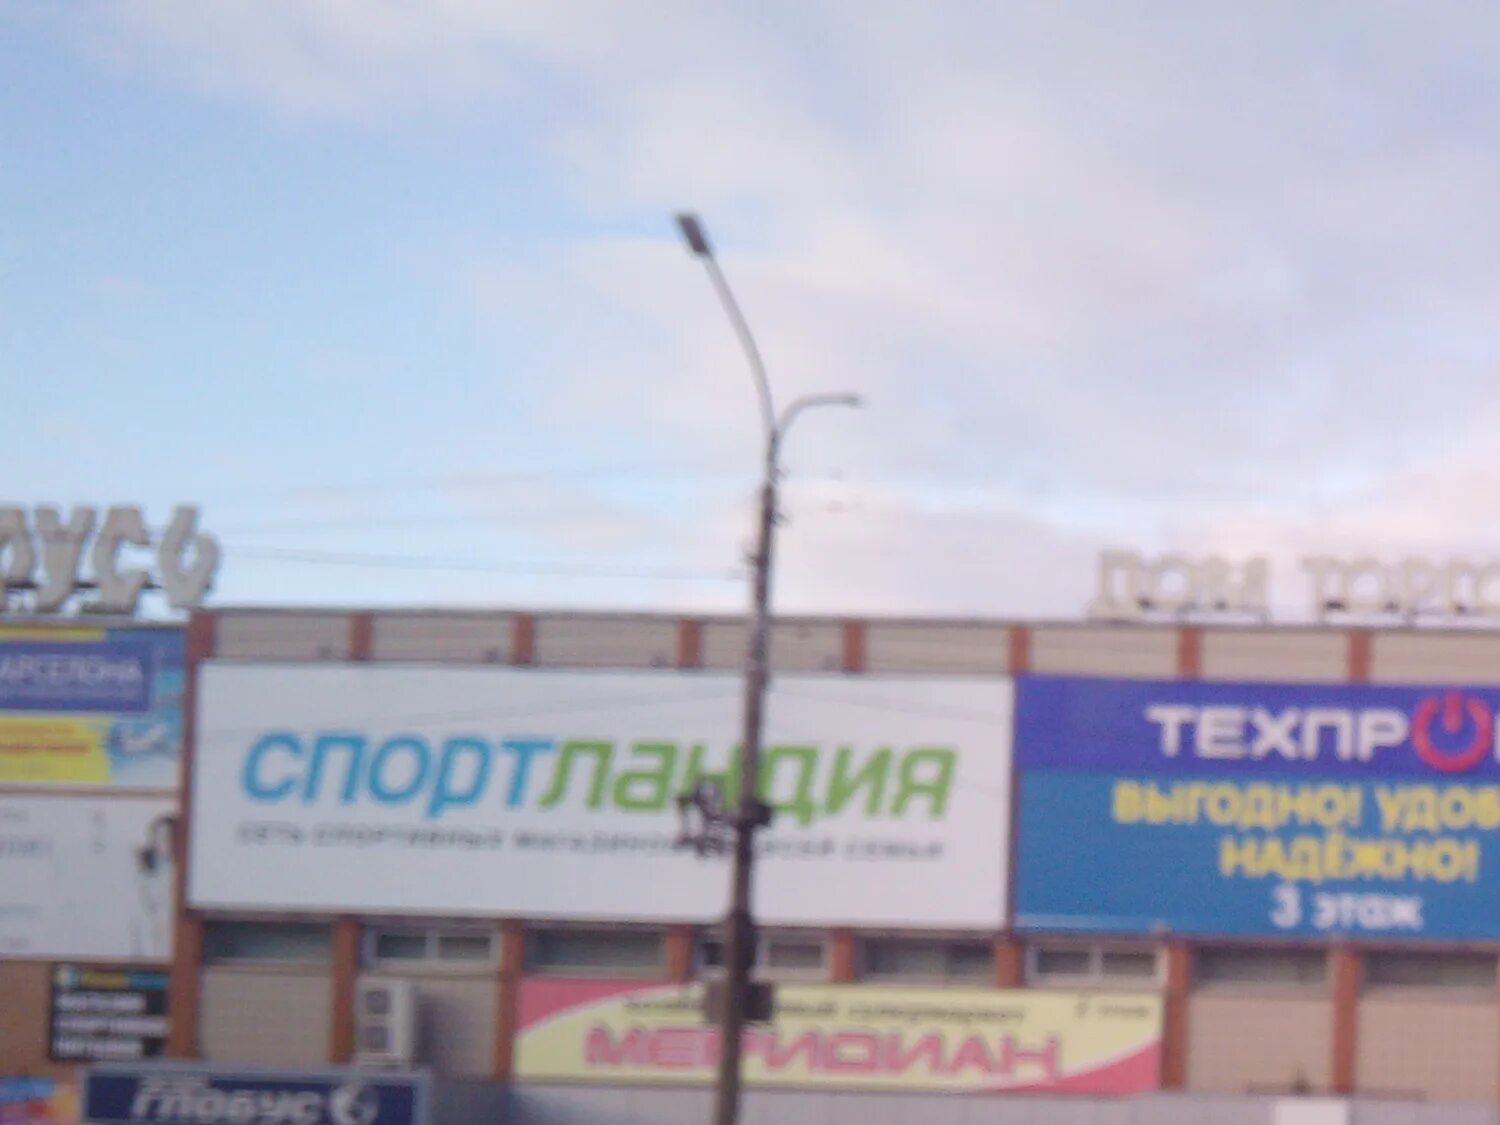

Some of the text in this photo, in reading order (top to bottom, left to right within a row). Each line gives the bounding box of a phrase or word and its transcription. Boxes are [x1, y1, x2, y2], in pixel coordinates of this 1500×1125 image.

[1112, 781, 1363, 829] ВЫГОДНО!
[1218, 830, 1478, 882] НАДЁЖНО!
[1268, 881, 1424, 929] 3 этаж
